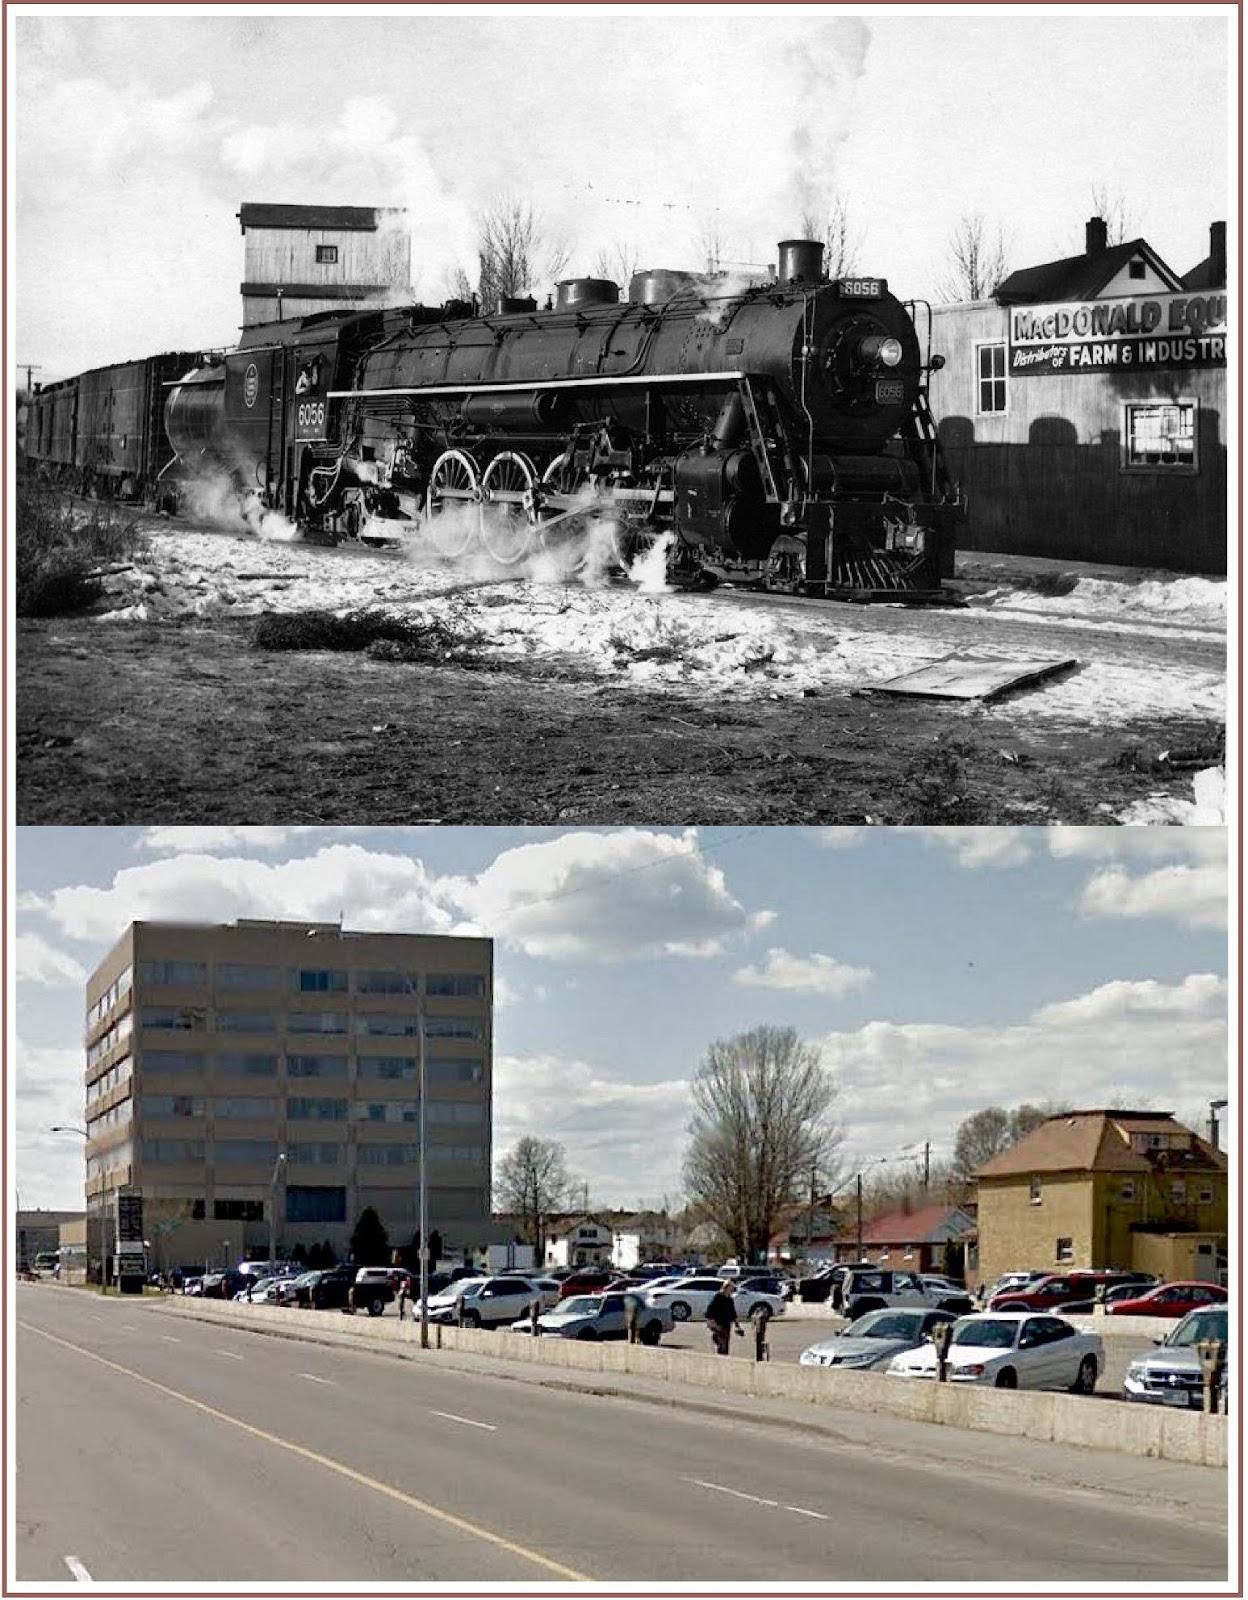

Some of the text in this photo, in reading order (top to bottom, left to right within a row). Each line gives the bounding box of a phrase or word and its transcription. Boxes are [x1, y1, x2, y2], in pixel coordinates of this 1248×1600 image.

[844, 281, 879, 295] 6056
[1052, 357, 1064, 368] OF
[1069, 343, 1118, 366] FARM
[1121, 345, 1133, 365] &
[879, 386, 902, 398] 6056
[298, 402, 325, 426] 6056
